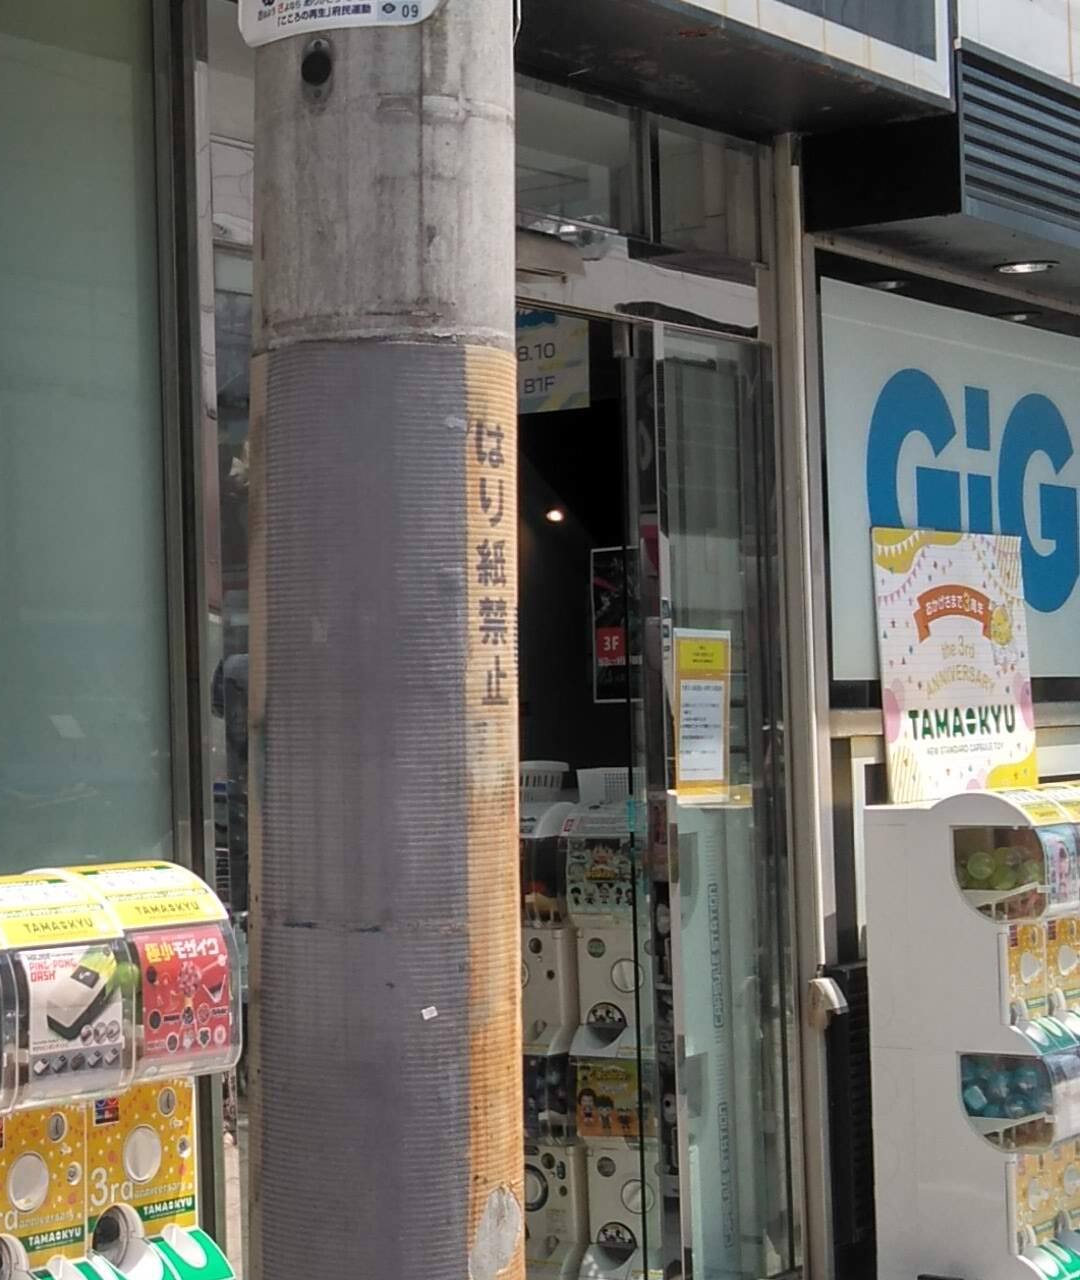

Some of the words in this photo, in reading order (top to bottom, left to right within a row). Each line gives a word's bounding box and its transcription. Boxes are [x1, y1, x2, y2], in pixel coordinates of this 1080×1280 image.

[401, 4, 419, 18] 09
[524, 375, 556, 394] B1F
[476, 421, 509, 706] はり紙禁止
[603, 636, 620, 651] 3F
[90, 1166, 135, 1206] 3rd
